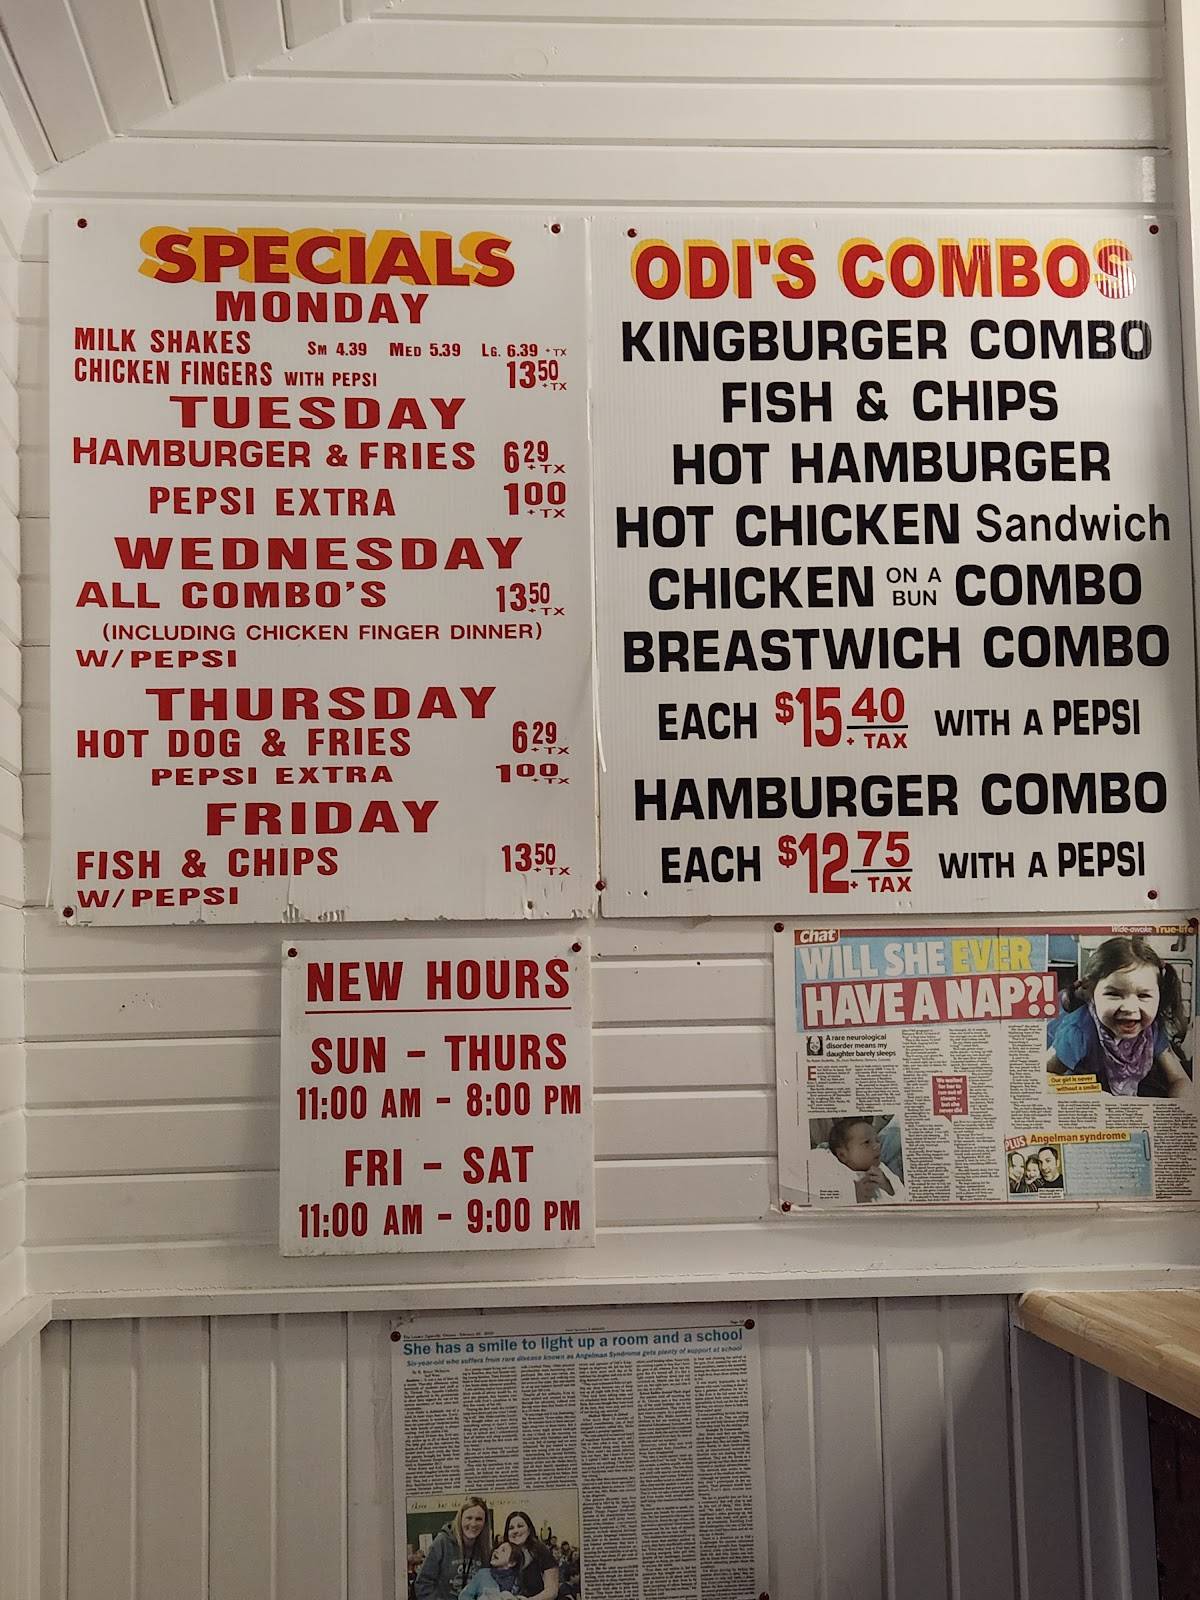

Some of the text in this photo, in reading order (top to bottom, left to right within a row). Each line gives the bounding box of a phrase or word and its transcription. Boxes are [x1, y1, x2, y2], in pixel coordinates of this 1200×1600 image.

[138, 226, 515, 287] SPECIALS
[631, 237, 1137, 300] ODI'S COMBOS
[216, 291, 428, 323] MONDAY
[75, 327, 136, 352] MILK
[151, 330, 250, 354] SHAKES
[336, 343, 367, 356] 4.39
[430, 343, 460, 356] 5.39
[507, 344, 537, 357] 6.39
[622, 320, 1152, 361] KINGBURGER COMBO
[75, 358, 169, 384] CHICKEN
[182, 361, 272, 386] FINGERS
[284, 372, 323, 386] WITH
[333, 373, 376, 386] PEPSI
[170, 396, 465, 429] TUESDAY
[723, 381, 1058, 423] FISH & CHIPS
[74, 437, 310, 467] HAMBURGER
[326, 444, 347, 466] &
[361, 442, 475, 470] FRIES
[673, 441, 1110, 484] HOT HAMBURGER
[150, 487, 254, 515] PEPSI
[276, 488, 395, 516] EXTRA
[617, 504, 1170, 548] HOT CHICKEN Sandwich
[115, 537, 522, 570] WEDNESDAY
[76, 582, 160, 608] ALL
[649, 563, 1141, 610] CHICKEN ON A BUN COMBO
[103, 622, 541, 641] (INCLUDING CHICKEN FINGER DINNER)
[624, 625, 1169, 672] BREASTWICH COMBO
[146, 687, 496, 720] THURSDAY
[659, 703, 757, 740] EACH
[864, 733, 907, 748] TAX
[934, 710, 1009, 736] WITH
[1024, 709, 1043, 735] A
[1054, 699, 1140, 735] PEPSI
[78, 730, 149, 758] HOT
[169, 729, 240, 757] DOG
[262, 729, 286, 757] &
[308, 728, 410, 756] FRIES
[152, 767, 256, 786] PEPSI
[276, 766, 392, 784] EXTRA
[635, 772, 1166, 820] HAMBURGER COMBO
[207, 801, 439, 836] FRIDAY
[78, 851, 159, 880] FISH
[182, 850, 206, 878] &
[229, 847, 337, 877] CHIPS
[662, 846, 760, 883] EACH
[868, 876, 911, 892] TAX
[939, 852, 1014, 878] WITH
[1028, 852, 1048, 877] A
[1058, 842, 1144, 877] PEPSI
[1155, 925, 1194, 934] True-life
[799, 937, 1032, 981] WILL SHE EVER
[308, 959, 569, 1002] NEW HOURS
[805, 975, 1056, 1027] HAVE A NAP?!
[311, 1034, 566, 1074] SUN THURS
[826, 1049, 896, 1059] daughter barely sleeps
[846, 1033, 887, 1041] neurological
[297, 1082, 580, 1120] 11:00 AM 8:00 PM
[1005, 1131, 1127, 1150] PLUS Angelman syndrome
[346, 1146, 533, 1186] FRI SAT
[299, 1198, 580, 1238] 11:00 AM 9:00 PM
[403, 1328, 743, 1356] She has a smile to light up a room and a school
[406, 1359, 444, 1368] Six-year-old
[461, 1356, 484, 1365] suffers
[485, 1356, 500, 1364] from
[516, 1354, 542, 1362] disease
[543, 1353, 565, 1361] known
[575, 1351, 608, 1360] Angelman
[609, 1350, 641, 1358] Syndrome
[642, 1350, 656, 1358] gets
[657, 1348, 677, 1357] plenty
[679, 1347, 686, 1355] of
[687, 1347, 711, 1355] support
[721, 1344, 743, 1352] school
